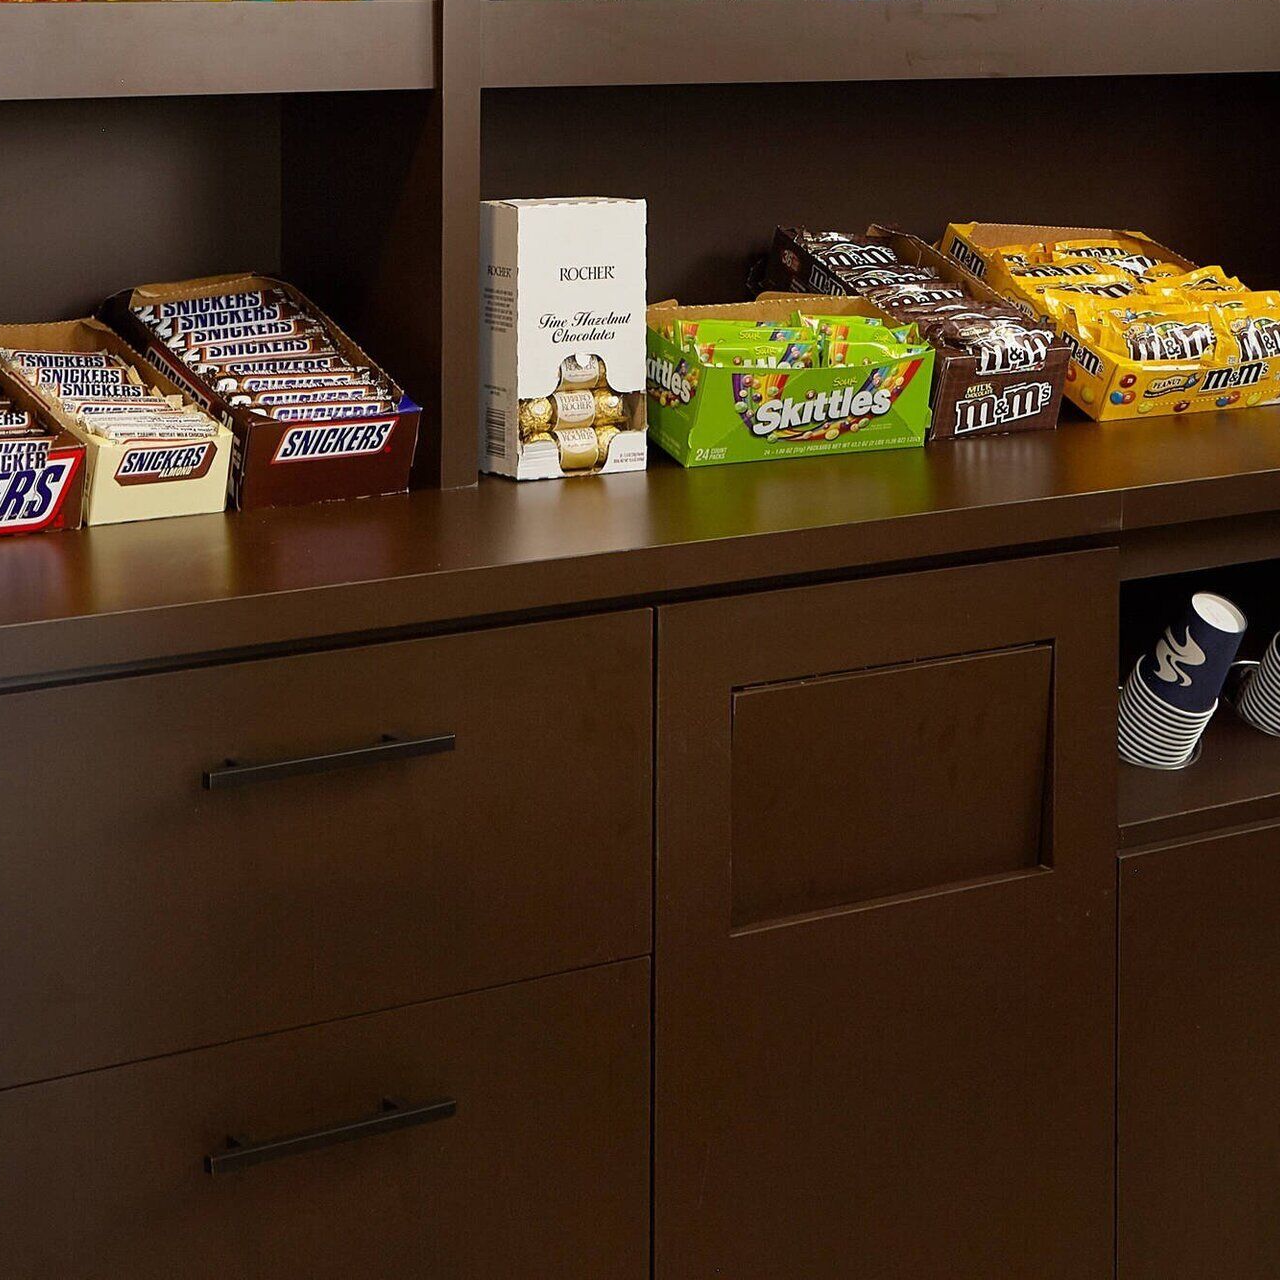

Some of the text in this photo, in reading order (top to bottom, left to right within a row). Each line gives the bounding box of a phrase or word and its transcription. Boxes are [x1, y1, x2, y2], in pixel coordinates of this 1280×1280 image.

[487, 265, 511, 278] ROCHER
[559, 266, 614, 282] ROCHER
[162, 291, 261, 319] SNICKERS
[180, 304, 279, 332] SNICKERS
[537, 311, 633, 330] Fine Hazelnut
[551, 327, 615, 344] Chocolates
[24, 355, 105, 368] SNICKERS
[1061, 330, 1105, 377] m&m's
[41, 369, 121, 384] SNICKERS
[832, 377, 858, 387] Sour
[1152, 377, 1182, 391] PEANUT
[1198, 361, 1269, 393] m&m's
[62, 383, 142, 397] SNICKERS
[966, 383, 993, 394] MILK
[752, 387, 893, 436] Skittles
[954, 381, 1052, 435] m&m's
[281, 423, 390, 458] SNICKERS
[121, 446, 207, 474] SNICKERS
[695, 448, 710, 461] 24
[158, 466, 193, 478] ALMOND
